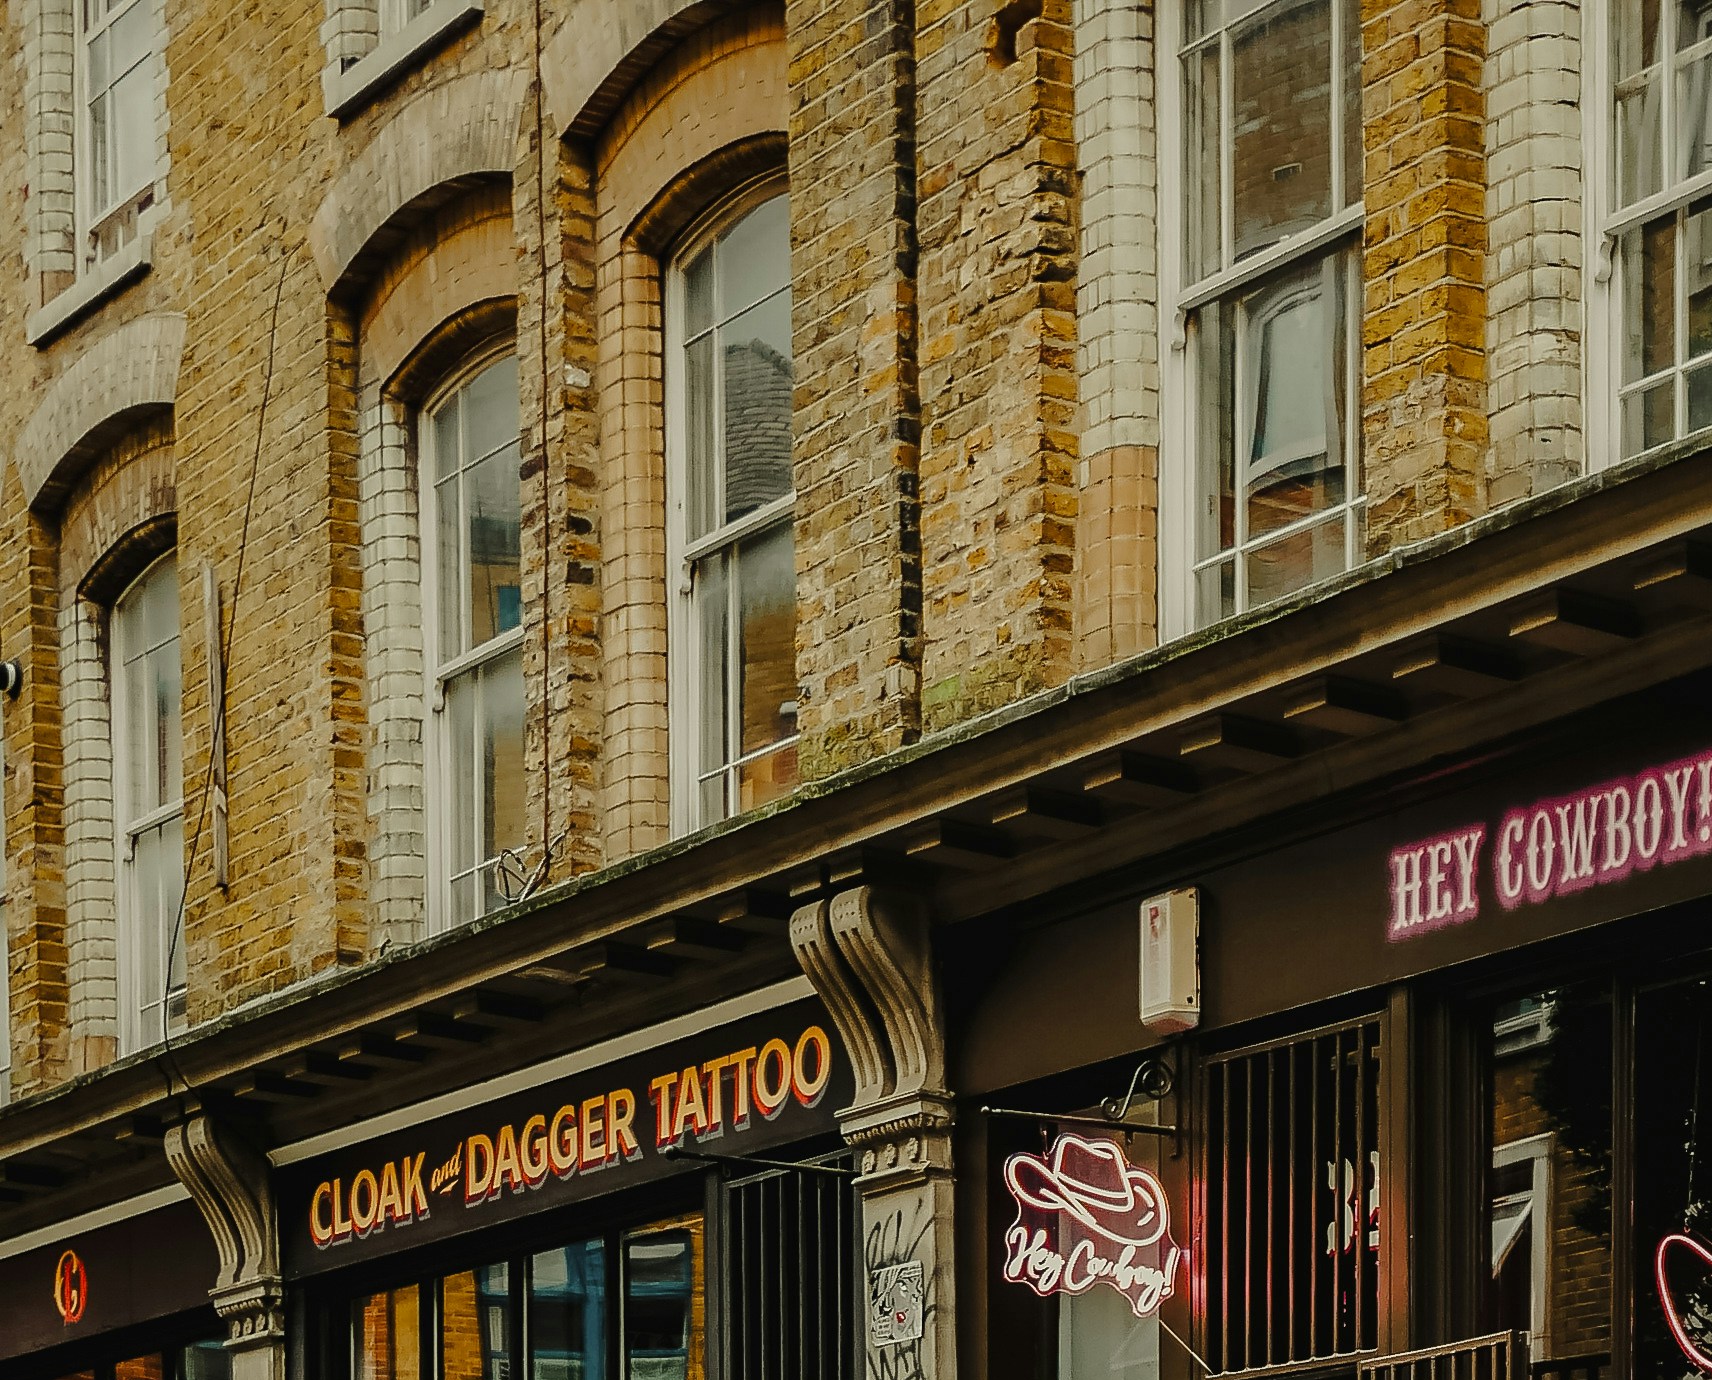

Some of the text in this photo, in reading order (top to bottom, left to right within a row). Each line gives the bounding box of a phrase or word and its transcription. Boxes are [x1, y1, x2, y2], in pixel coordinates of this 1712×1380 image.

[1393, 831, 1483, 931] HEY
[310, 1025, 833, 1249] CLOAK and DAGGER TATTOO
[1007, 1226, 1065, 1292] Hey
[1065, 1238, 1180, 1314] Cowboy!
